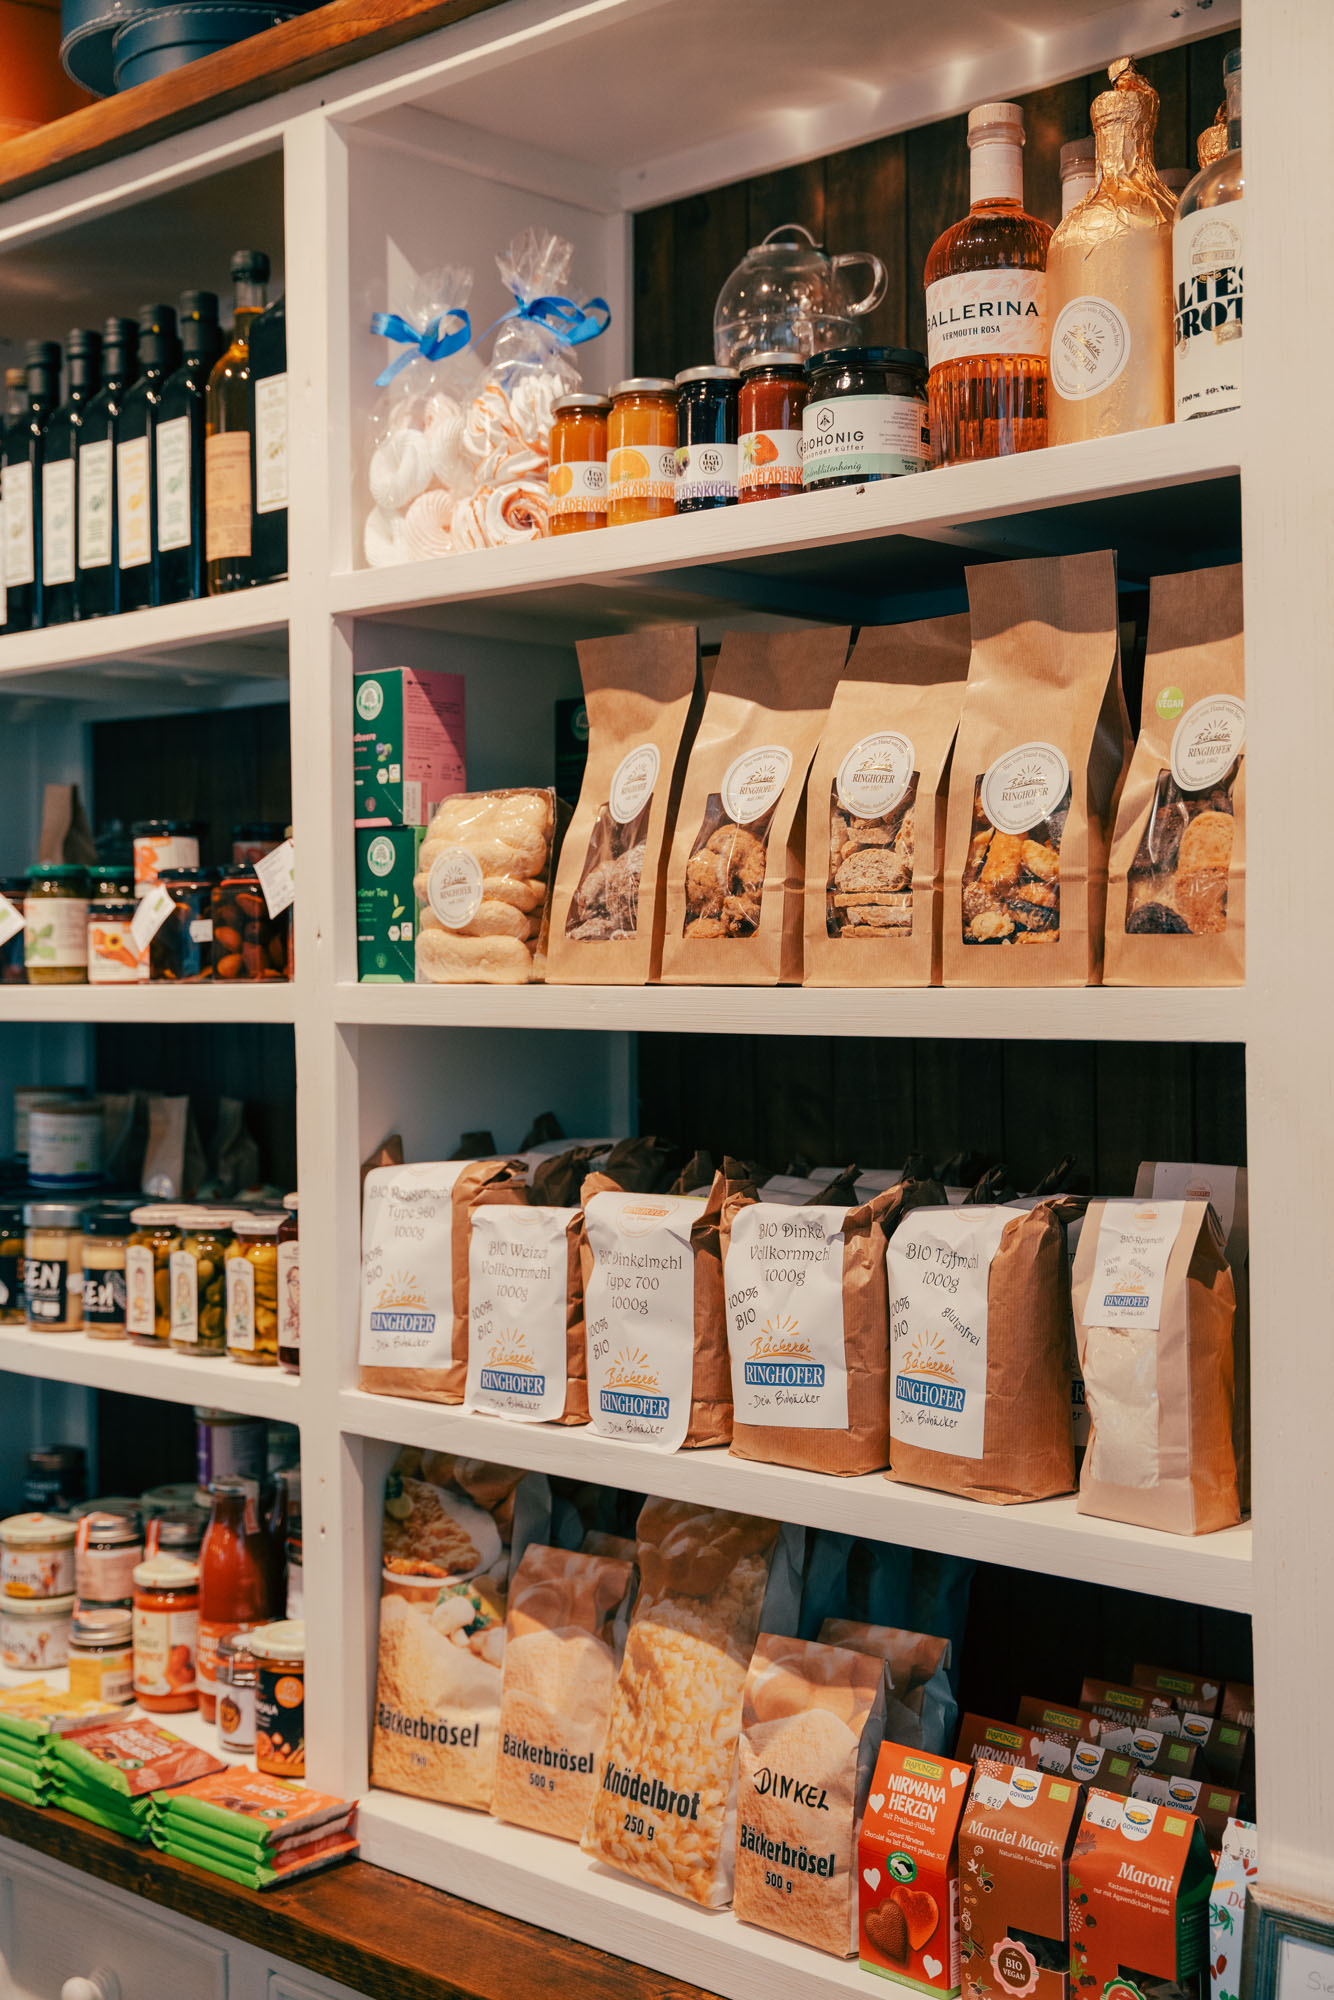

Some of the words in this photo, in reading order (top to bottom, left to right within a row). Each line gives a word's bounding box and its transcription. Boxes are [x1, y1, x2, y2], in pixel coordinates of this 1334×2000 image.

[943, 327, 978, 341] VERMOUTH
[981, 325, 1001, 335] ROSA
[1158, 699, 1184, 709] VEGAN
[1187, 744, 1233, 758] RINGHOFER
[852, 773, 895, 784] RINGHOFER
[739, 784, 776, 796] RINGHOFER
[1001, 787, 1049, 802] RINGHOFER
[376, 887, 389, 897] Tee
[759, 1222, 778, 1240] BIO
[488, 1241, 507, 1257] BIO
[906, 1242, 932, 1261] BIO
[481, 1260, 551, 1280] Vollkornmehl
[612, 1253, 682, 1270] Dinkelmehl
[606, 1272, 632, 1291] Type
[635, 1276, 660, 1291] 700
[765, 1268, 806, 1287] 1000g
[922, 1271, 960, 1294] 1000g
[496, 1284, 528, 1303] 1000g
[728, 1286, 759, 1309] 100%
[1104, 1295, 1149, 1307] RINGHOFER
[611, 1296, 649, 1315] 1000g
[371, 1312, 435, 1332] RINGHOFER
[735, 1308, 757, 1331] BIO
[941, 1307, 981, 1347] glutenfrei
[478, 1320, 494, 1341] BIO
[893, 1319, 909, 1342] BIO
[593, 1339, 610, 1360] BIO
[748, 1336, 813, 1359] Bäckerei
[484, 1347, 537, 1370] Bäckerei
[899, 1351, 957, 1381] Bäckerei
[481, 1370, 545, 1396] RINGHOFER
[603, 1367, 661, 1393] Bäckerei
[745, 1364, 824, 1386] RINGHOFER
[776, 1390, 820, 1406] Biobäcker
[896, 1376, 965, 1411] RINGHOFER
[601, 1392, 669, 1418] RINGHOFER
[916, 1410, 959, 1428] Biobäcker
[377, 1702, 480, 1748] Bäckerbrösel
[503, 1733, 595, 1774] Bäckerbrösel
[970, 1743, 1026, 1768] NIRWANA
[1130, 1750, 1154, 1761] GOVINDA
[905, 1759, 941, 1777] RAPUNZEL
[1072, 1763, 1096, 1775] GOVINDA
[529, 1772, 546, 1788] 500
[548, 1779, 555, 1792] g
[603, 1761, 700, 1821] Knödelbrot
[753, 1767, 830, 1811] DINKEL
[887, 1773, 946, 1805] NIRWANA
[974, 1792, 980, 1801] €
[1009, 1790, 1034, 1801] GOVINDA
[1166, 1800, 1193, 1811] GOVINDA
[882, 1812, 894, 1820] mit
[889, 1792, 938, 1823] HERZEN
[1087, 1811, 1094, 1820] €
[624, 1813, 644, 1836] 250
[647, 1825, 655, 1841] g
[1122, 1822, 1148, 1834] GOVINDA
[967, 1820, 1018, 1846] Mandel
[1017, 1833, 1060, 1858] Magic
[1223, 1843, 1230, 1852] €
[740, 1824, 836, 1878] Bäckerbrösel
[765, 1870, 783, 1889] 500
[786, 1879, 793, 1893] g
[1117, 1861, 1175, 1893] Maroni
[1102, 1889, 1113, 1897] mit
[1113, 1893, 1151, 1910] Agavendicksaft
[1108, 1881, 1170, 1907] Kastanien-Fruchtkonfekt
[1005, 1957, 1023, 1971] BIO
[1002, 1968, 1026, 1982] VEGAN
